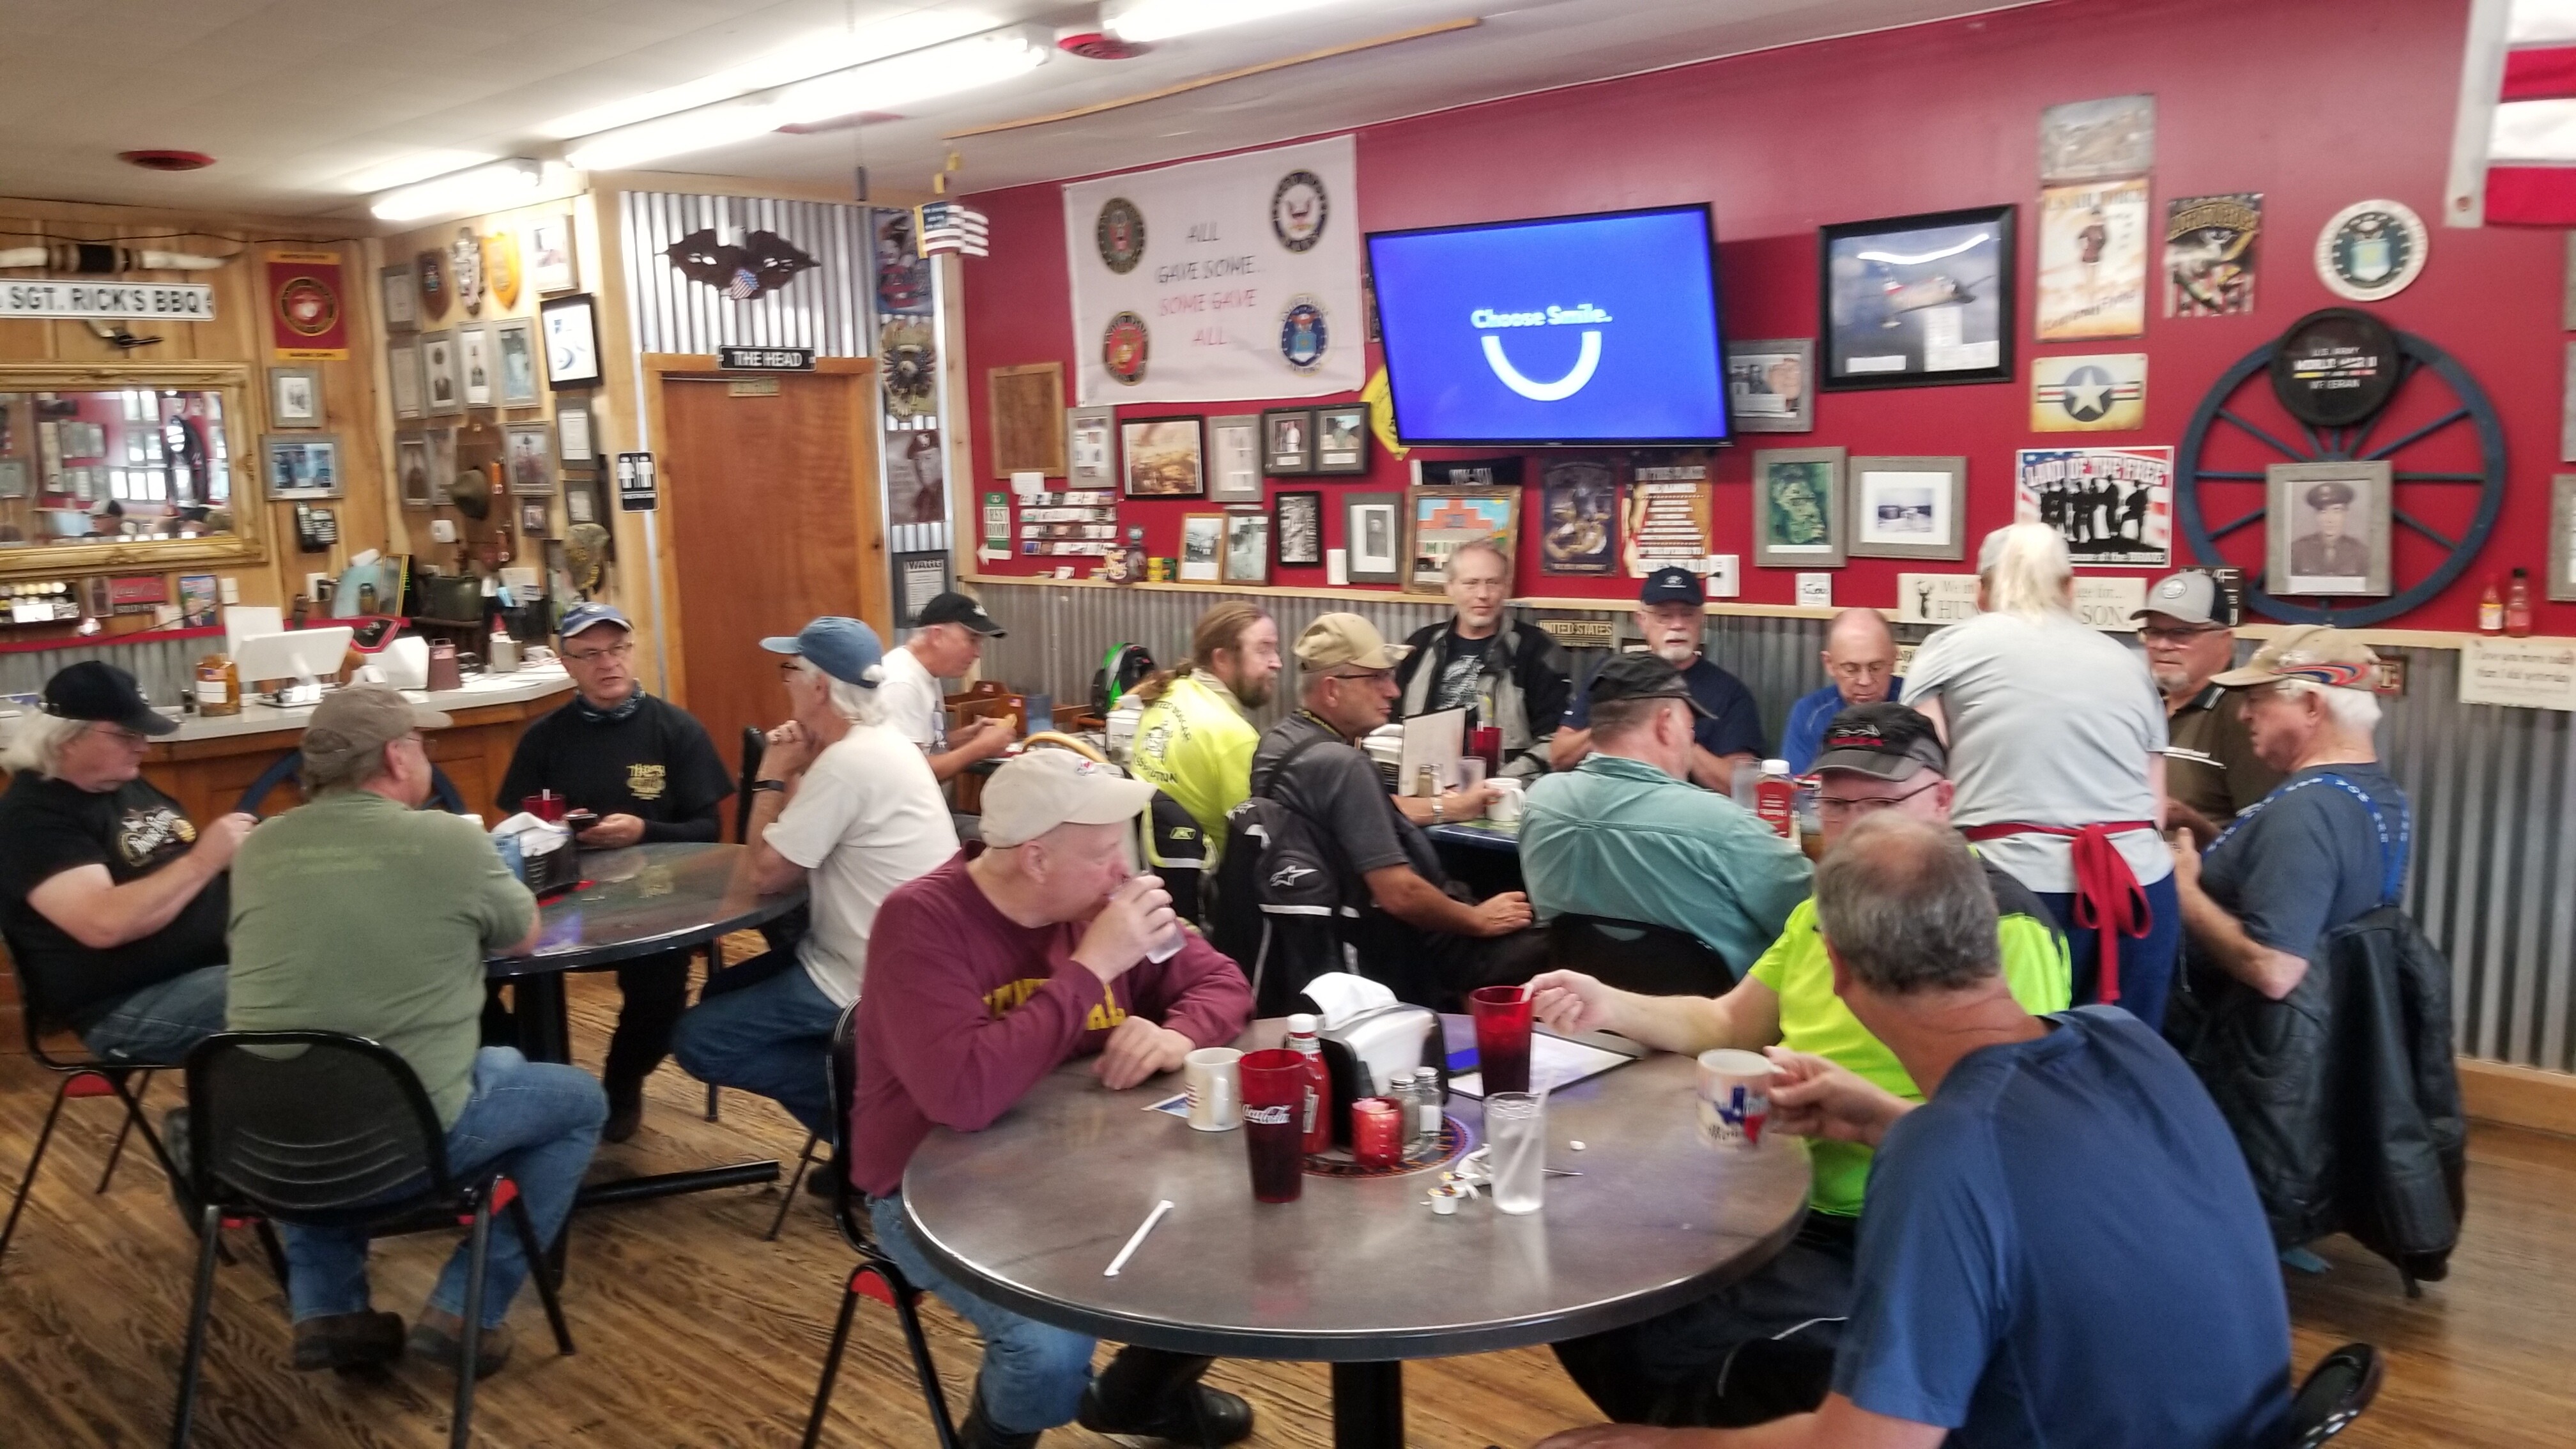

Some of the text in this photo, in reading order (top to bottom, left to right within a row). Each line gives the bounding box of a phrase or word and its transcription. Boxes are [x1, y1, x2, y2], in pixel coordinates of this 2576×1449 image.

[1185, 222, 1220, 243] ALL
[1154, 263, 1199, 284] GAVE
[10, 286, 200, 313] SGT. RICK'S BBQ
[1158, 293, 1206, 317] SOME
[1212, 289, 1258, 310] GAVE
[1471, 303, 1613, 328] Choose Smile.
[732, 351, 803, 367] THE HEAD
[2025, 456, 2166, 487] LAND OF THE FREE
[1538, 622, 1613, 636] UNITED STATES
